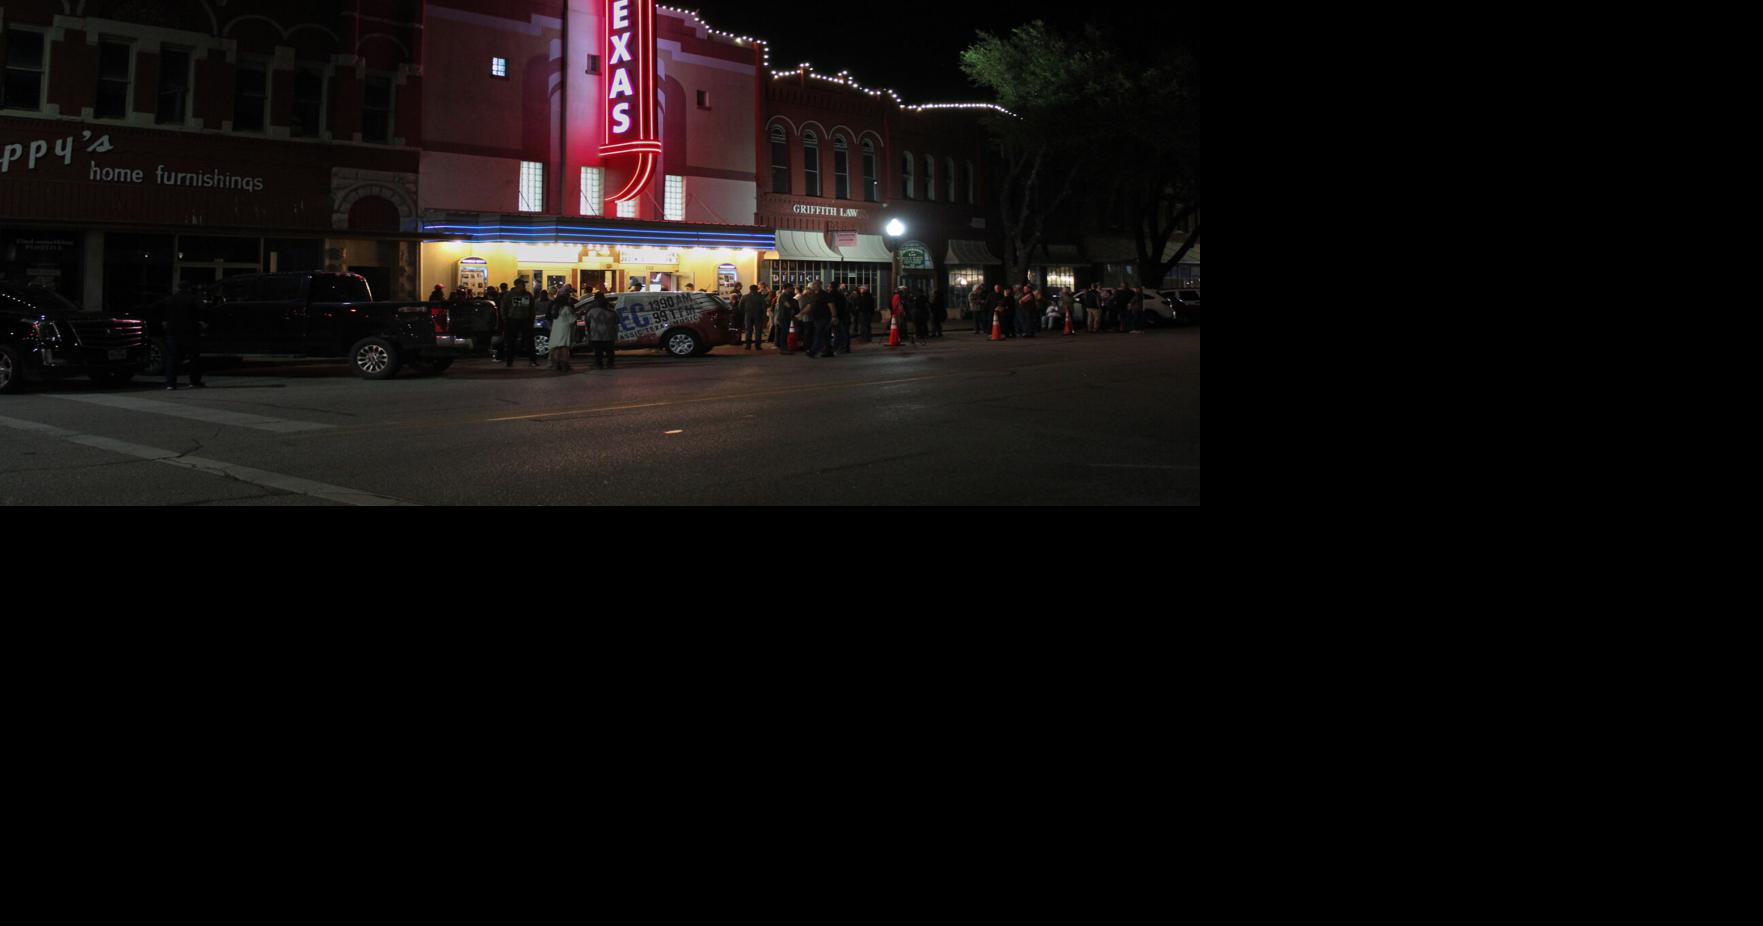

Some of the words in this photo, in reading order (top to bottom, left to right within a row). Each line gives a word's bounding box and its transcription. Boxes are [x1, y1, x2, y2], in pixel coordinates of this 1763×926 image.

[89, 160, 144, 183] home
[155, 164, 264, 193] furnishings
[793, 204, 837, 216] GRIFFITH
[839, 207, 859, 217] LAW
[648, 296, 674, 311] 1390
[675, 293, 691, 305] AM
